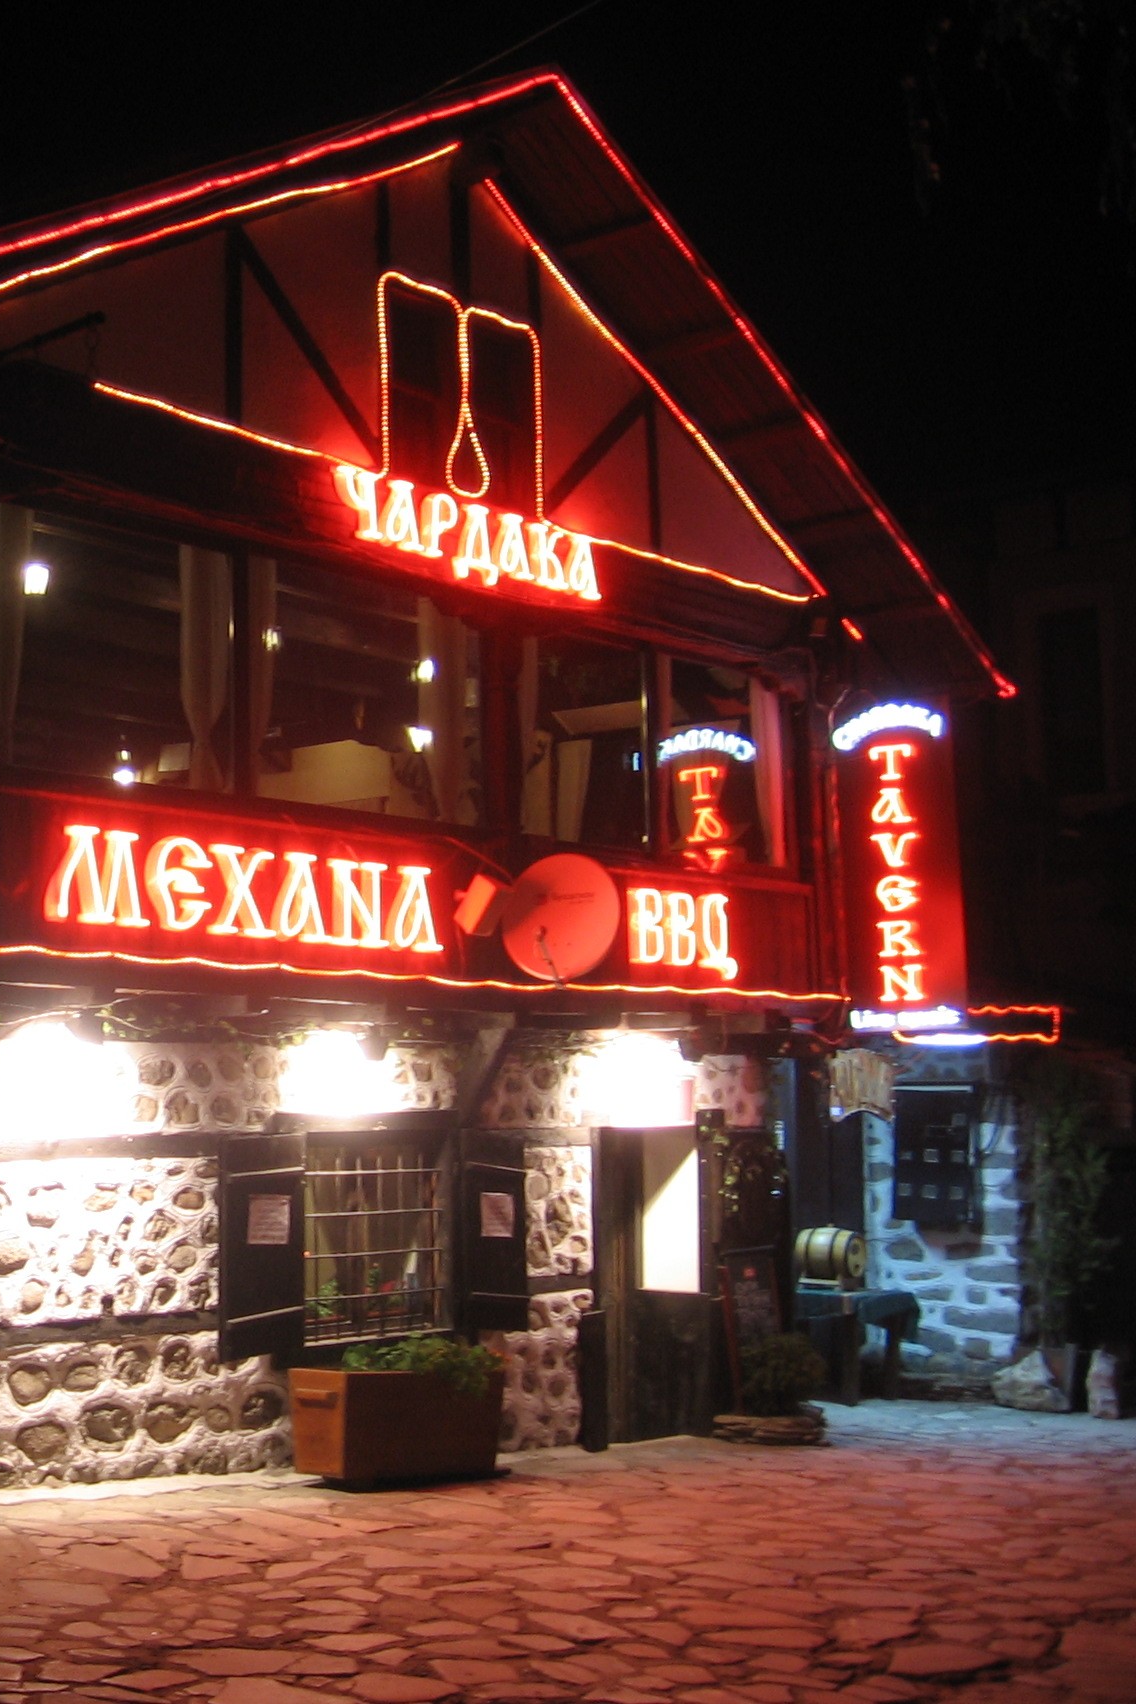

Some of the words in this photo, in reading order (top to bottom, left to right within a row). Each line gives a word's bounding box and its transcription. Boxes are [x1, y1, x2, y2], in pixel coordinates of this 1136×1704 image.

[333, 465, 602, 601] ЧАРДАКА
[627, 887, 739, 981] BBQ
[868, 742, 927, 1002] TAVERN
